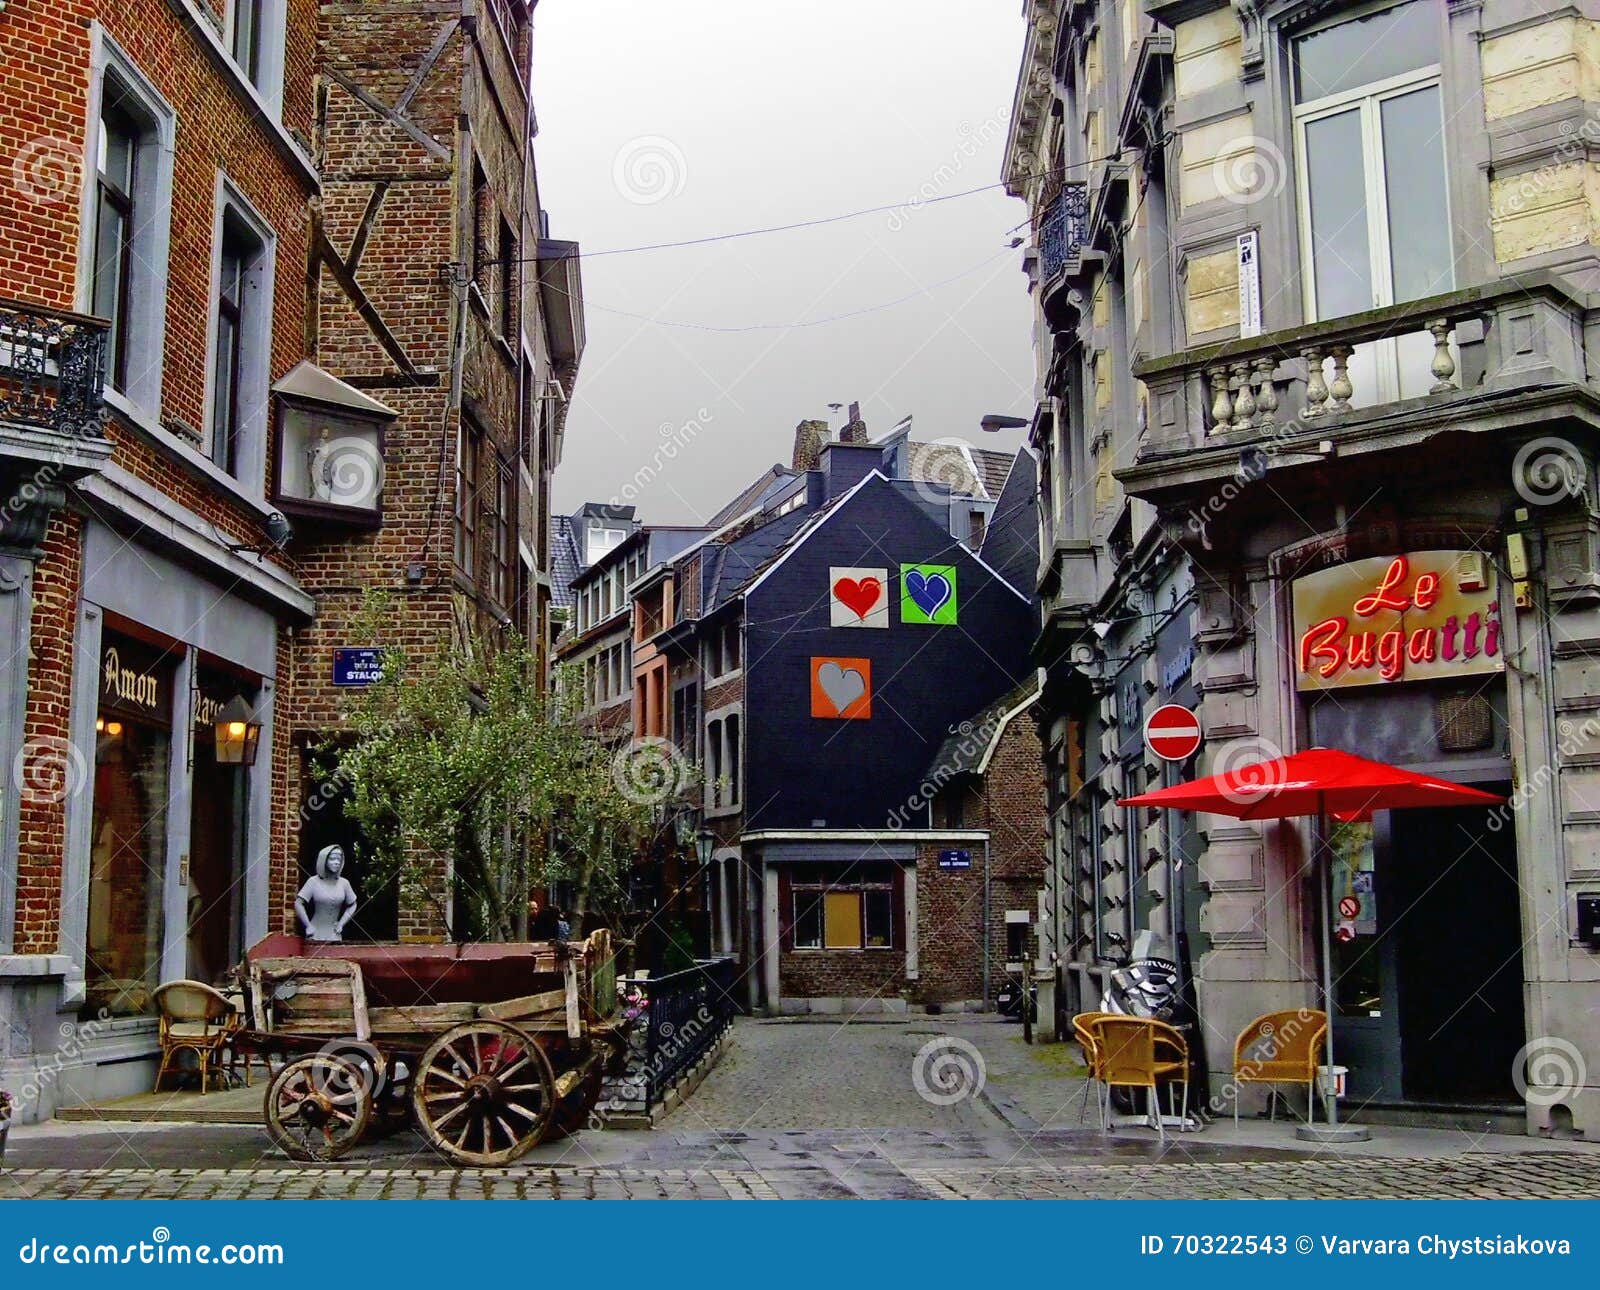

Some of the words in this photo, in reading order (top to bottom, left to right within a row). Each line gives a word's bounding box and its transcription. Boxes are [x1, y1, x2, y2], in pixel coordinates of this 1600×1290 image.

[1353, 555, 1440, 616] Le
[1301, 601, 1499, 681] Bugatti
[105, 647, 158, 708] Amon
